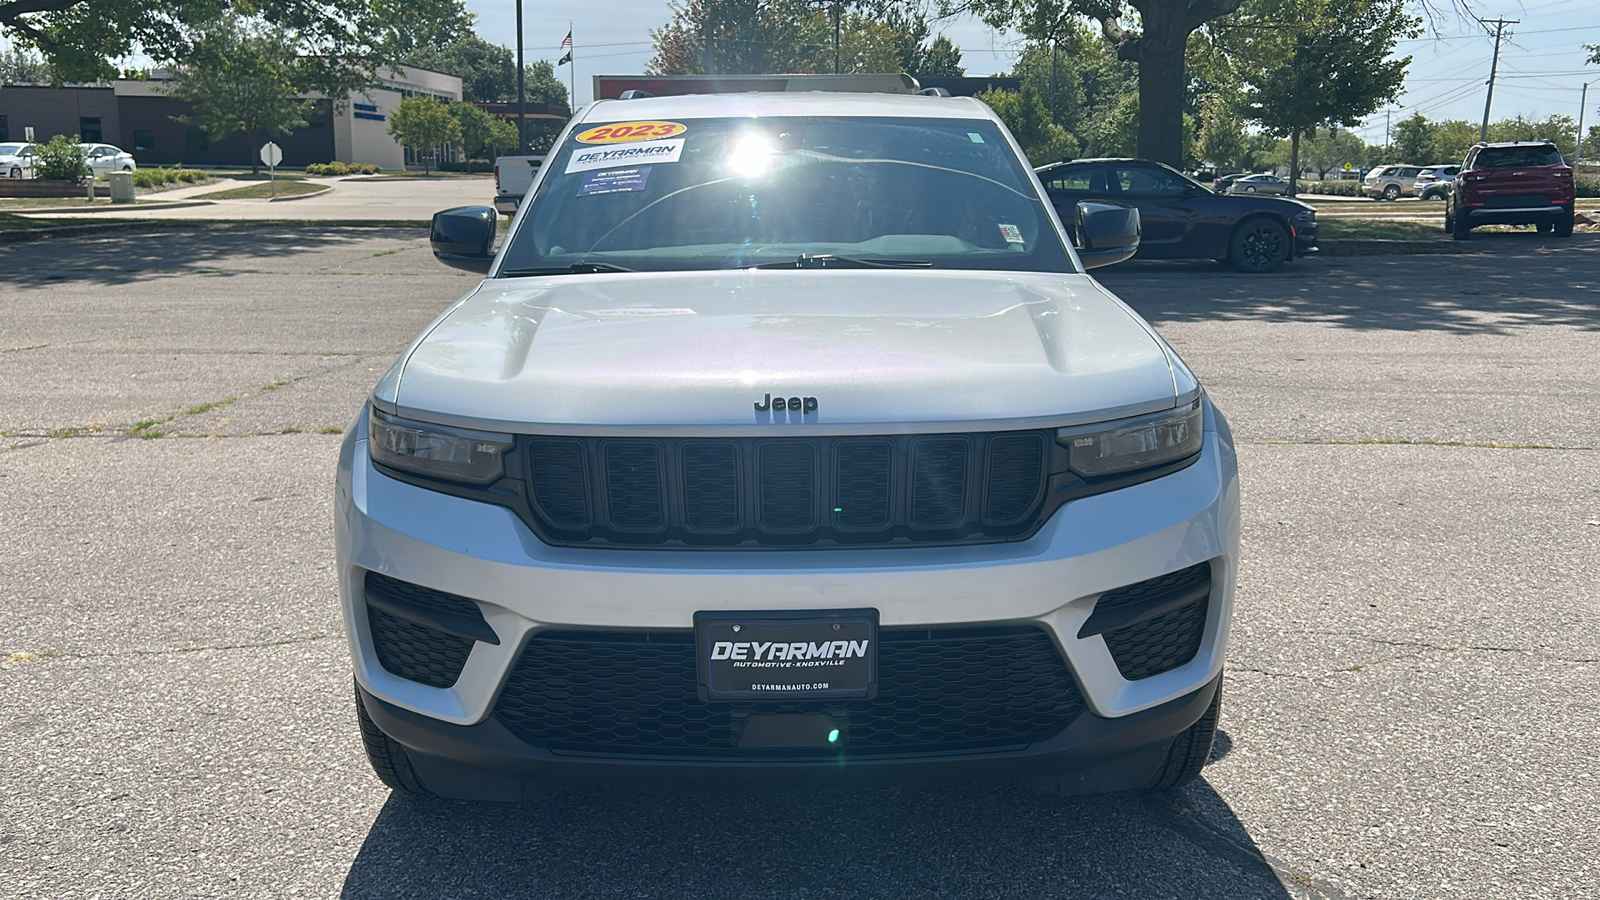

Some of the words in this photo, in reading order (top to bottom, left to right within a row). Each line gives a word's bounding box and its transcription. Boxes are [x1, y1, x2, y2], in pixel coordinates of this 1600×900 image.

[586, 125, 676, 140] 2023
[577, 146, 676, 161] DEYARMAN
[582, 156, 623, 164] CERTIFIED
[754, 393, 818, 414] Jeep
[711, 640, 868, 660] DEYARMAN
[752, 683, 829, 691] DEYARMANAUTO.COM
